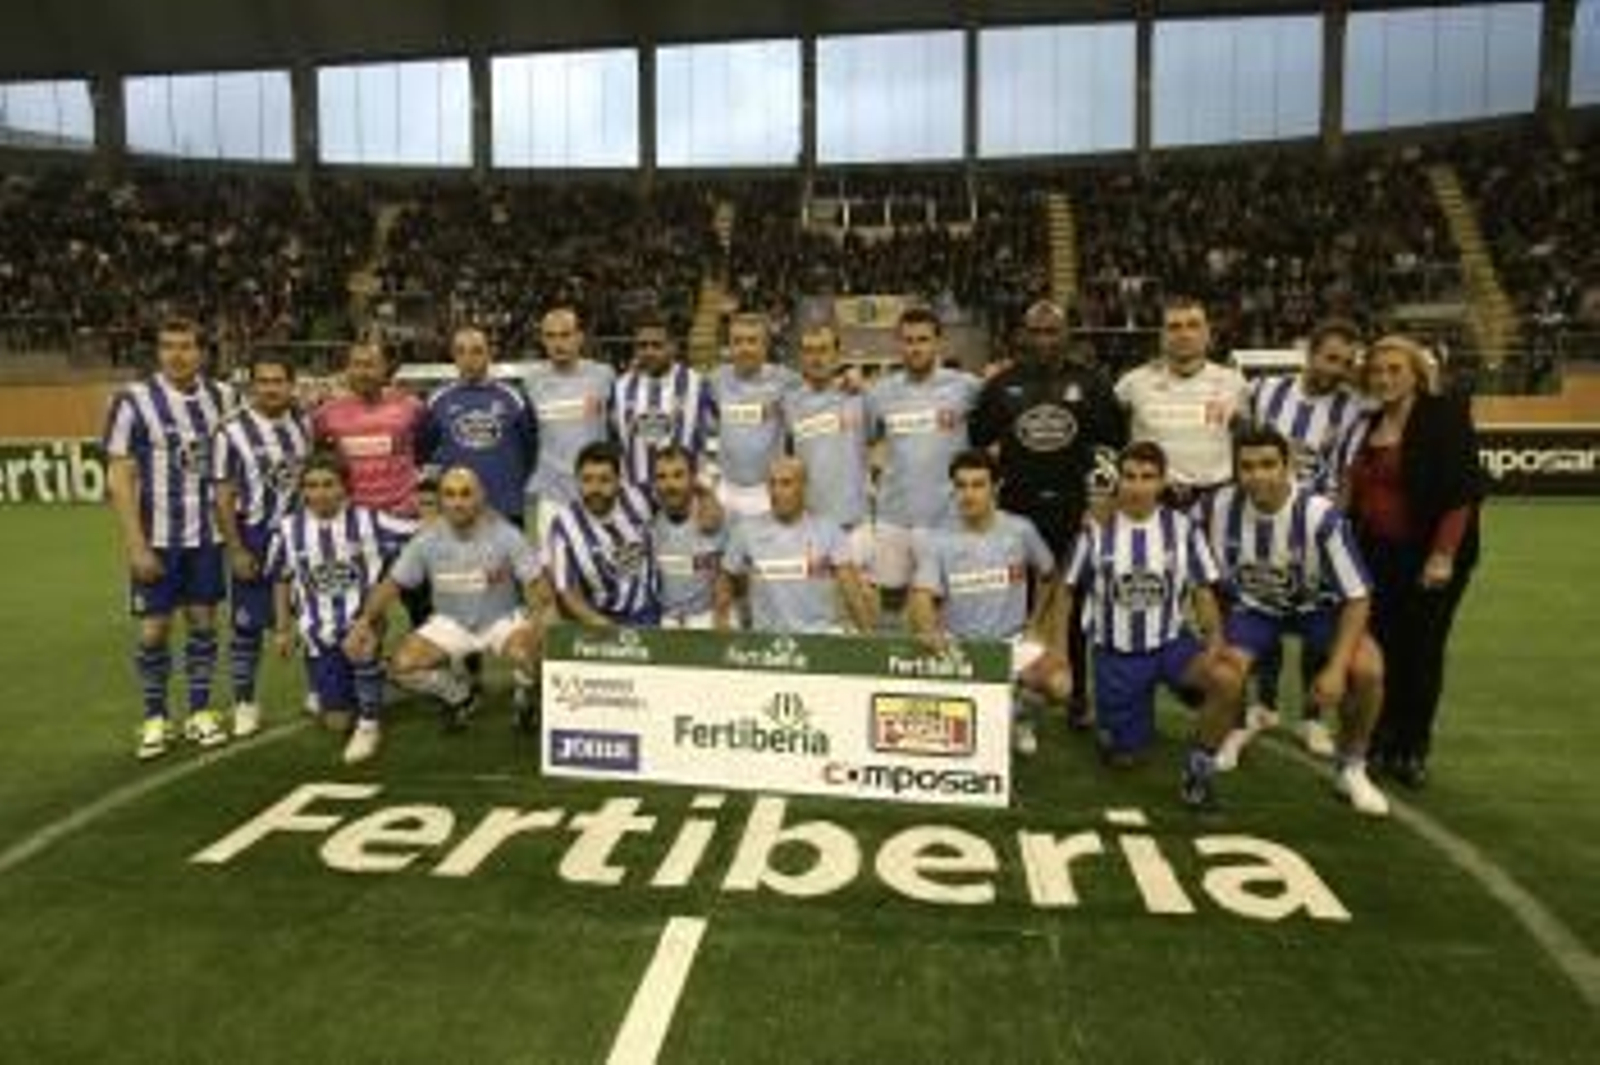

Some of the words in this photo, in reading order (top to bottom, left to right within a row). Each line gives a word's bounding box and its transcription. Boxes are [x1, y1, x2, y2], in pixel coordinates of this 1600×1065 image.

[0, 440, 104, 501] rtib
[674, 715, 829, 755] Fertiberia
[190, 784, 1352, 922] Fertiberia
